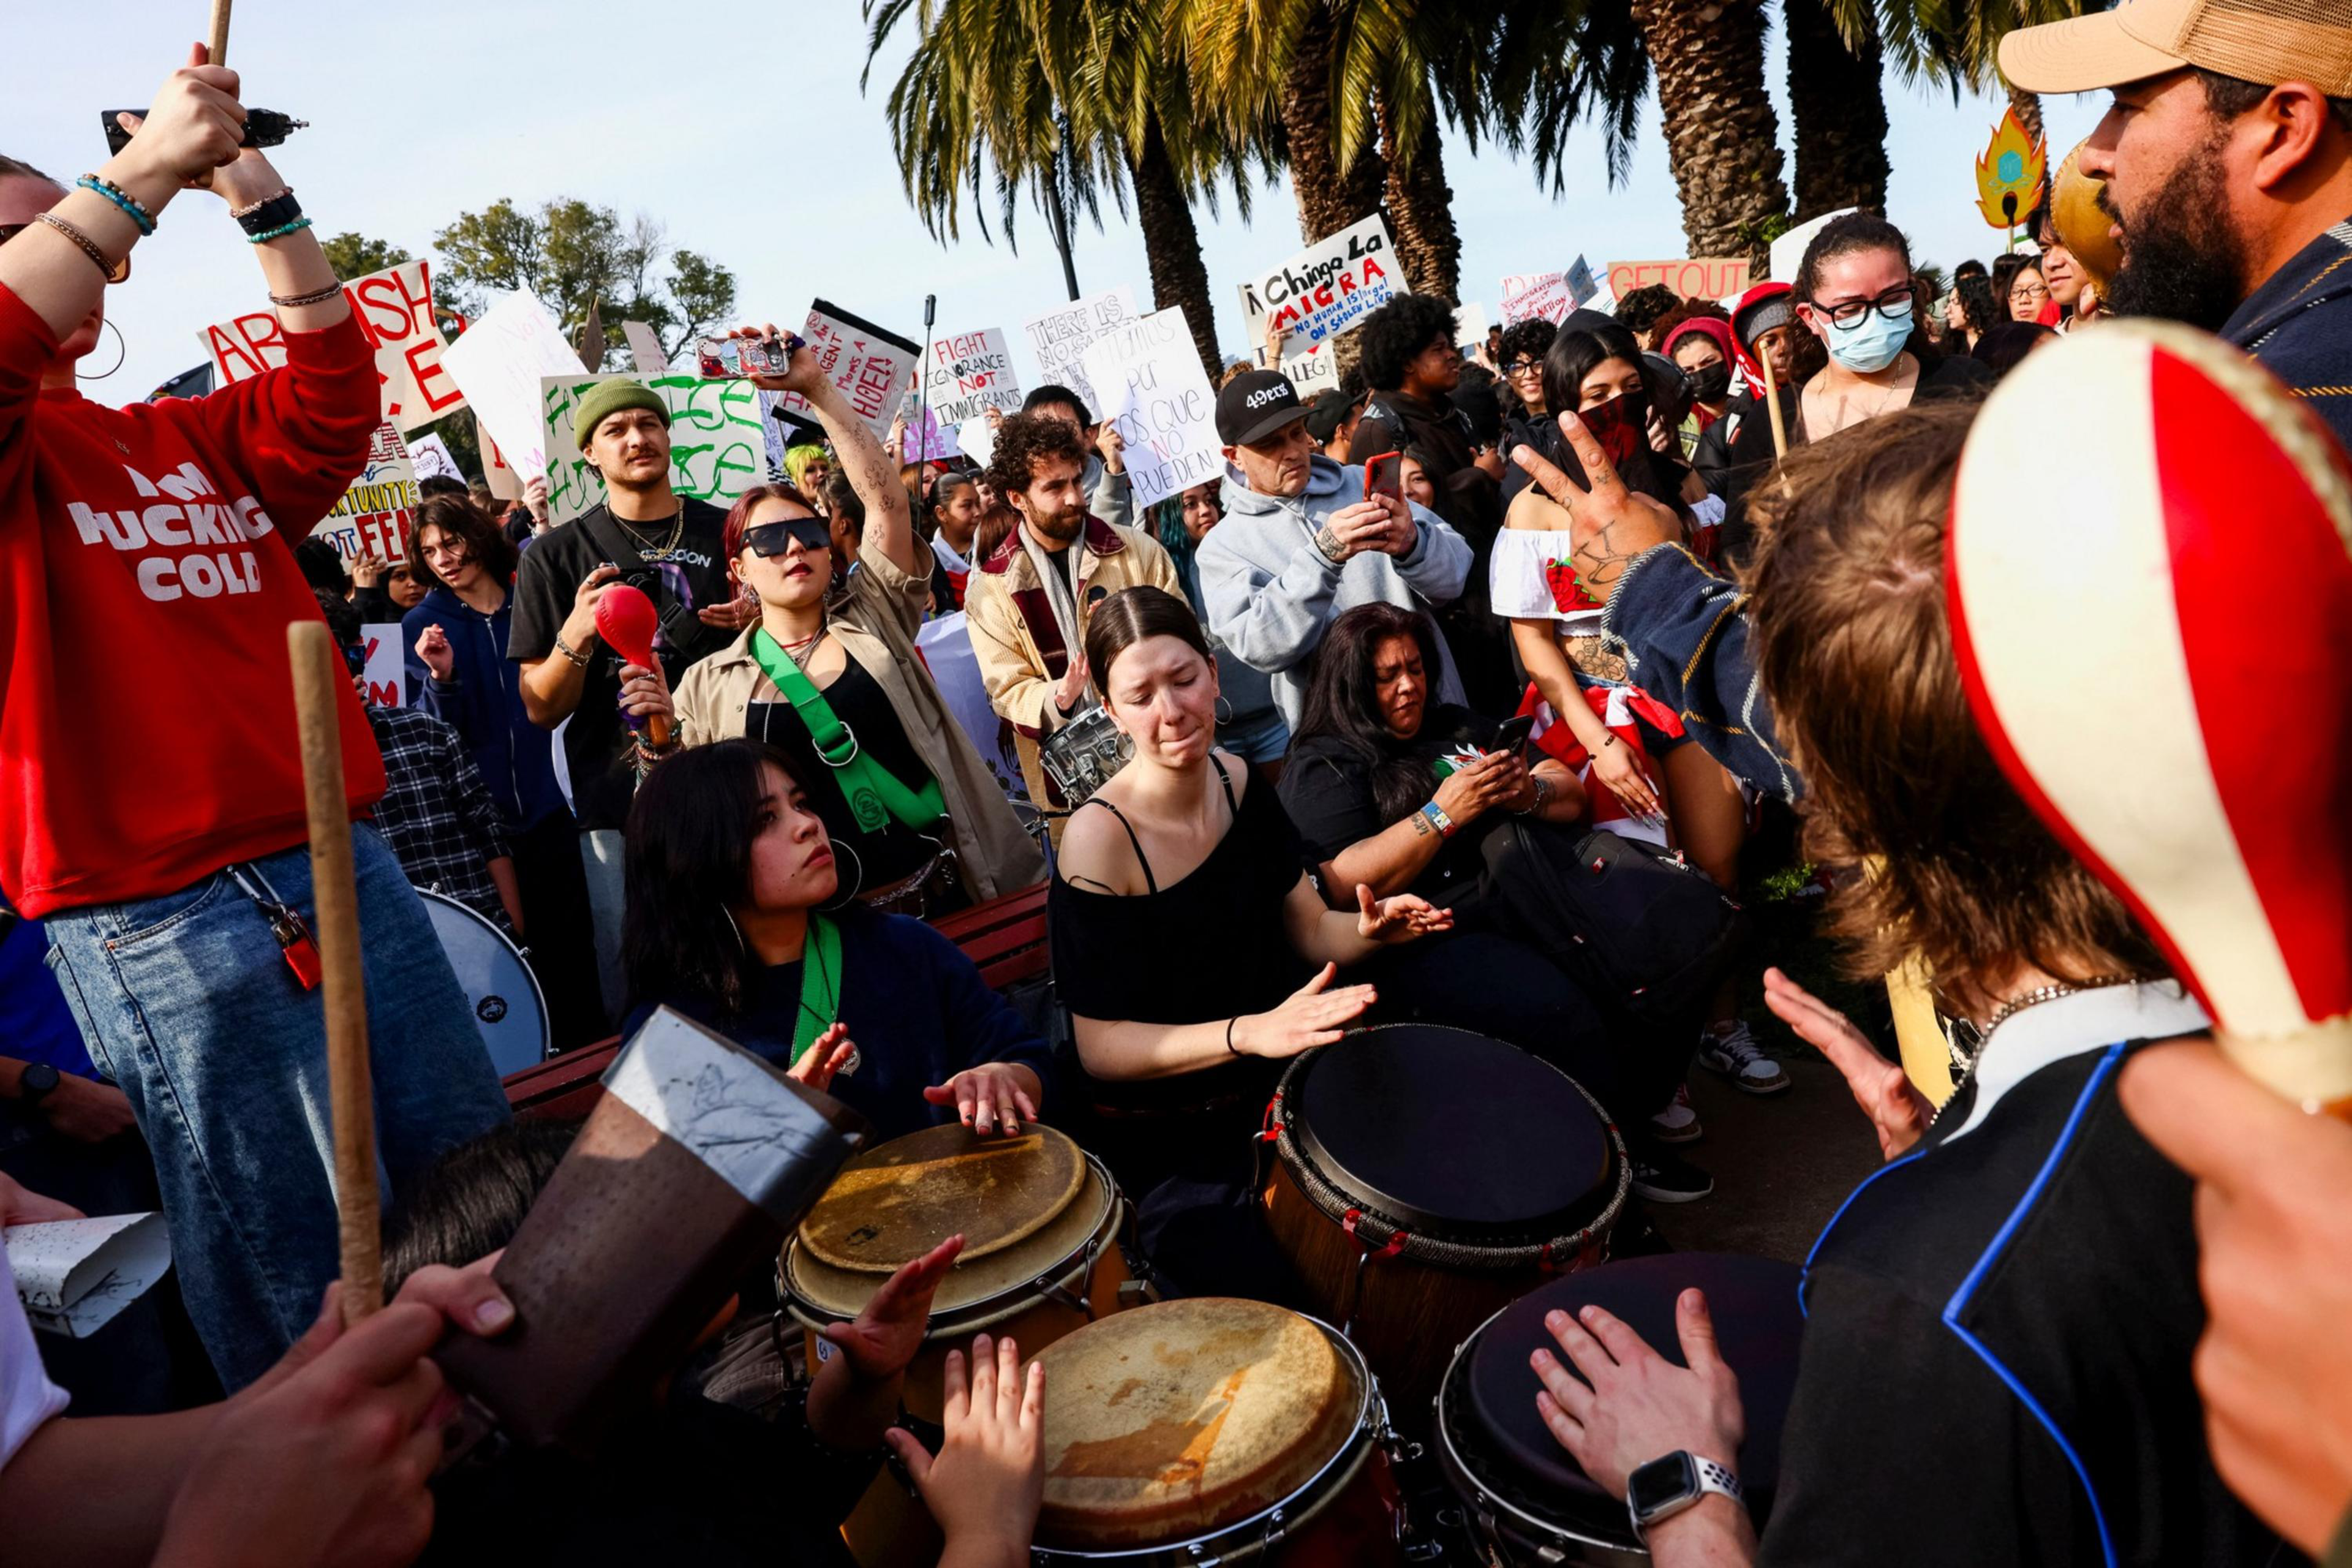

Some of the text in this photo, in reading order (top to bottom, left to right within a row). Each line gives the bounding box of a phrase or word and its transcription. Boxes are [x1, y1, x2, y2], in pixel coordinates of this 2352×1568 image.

[1265, 257, 1343, 305] Chinga
[1348, 235, 1382, 260] La
[1610, 265, 1677, 304] GET
[1678, 263, 1747, 300] OUT
[1274, 257, 1385, 330] MIGRA
[1510, 277, 1561, 309] IMMIGRATION
[1537, 295, 1567, 318] NATION
[1026, 295, 1123, 348] THERE IS
[1295, 319, 1311, 334] NO
[1313, 301, 1343, 323] HUMAN
[1347, 289, 1358, 305] IS
[853, 339, 866, 353] A
[934, 333, 987, 364] FIGHT
[1310, 325, 1327, 341] ON
[923, 354, 1006, 389] IGNORANCE
[1036, 342, 1069, 369] NO
[958, 371, 996, 396] NOT
[1246, 382, 1289, 410] 49ers
[934, 388, 1023, 428] IMMIGRANTS
[1151, 430, 1184, 462] NO
[1134, 449, 1215, 503] PUEDEN
[354, 507, 415, 563] FEA
